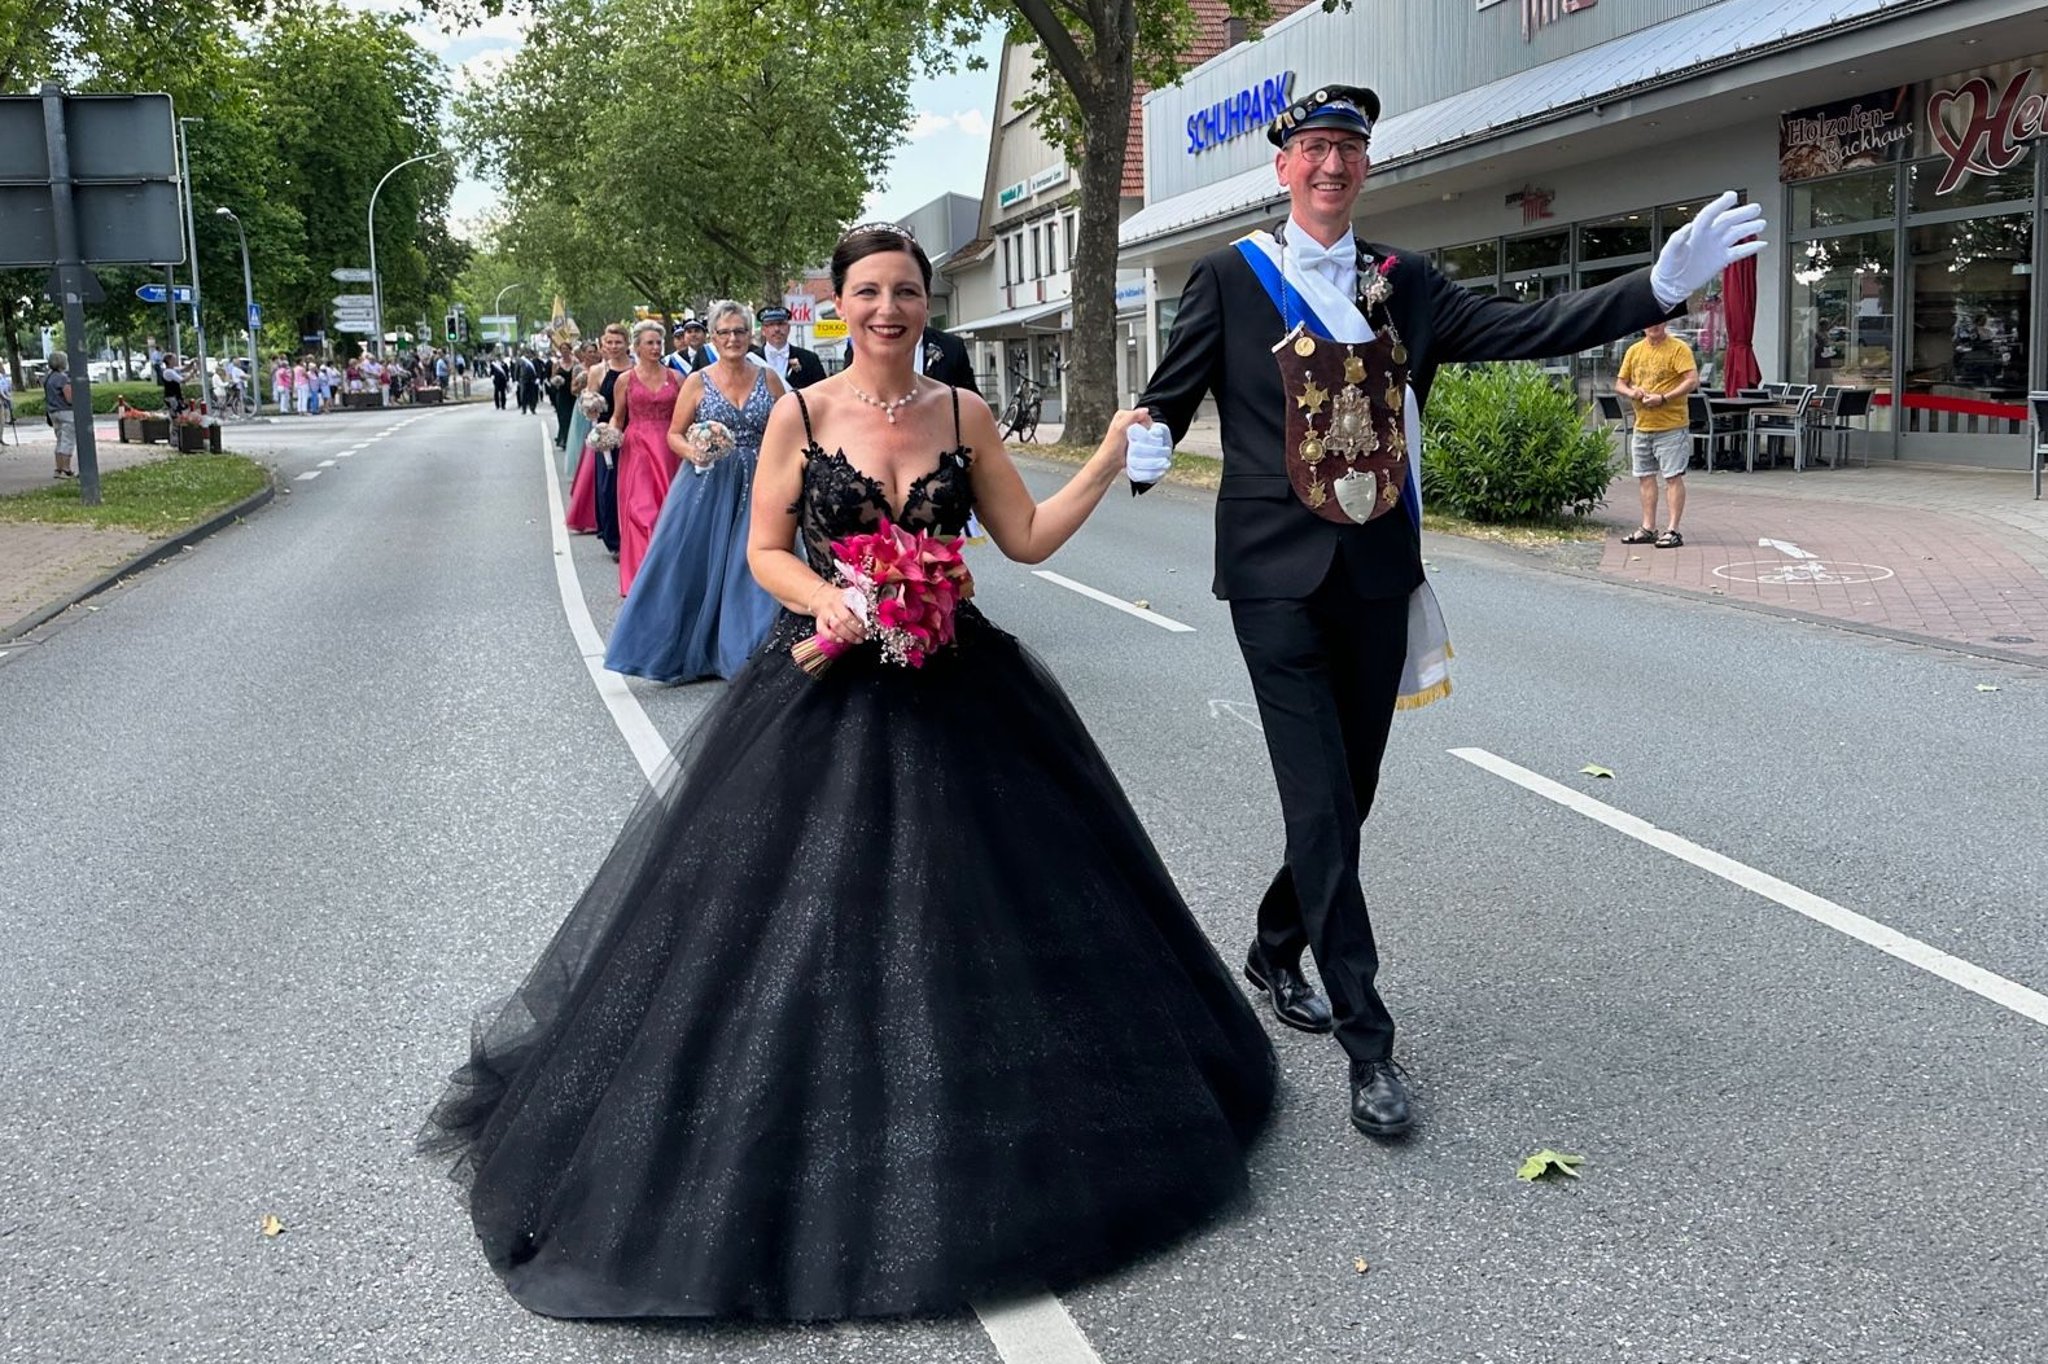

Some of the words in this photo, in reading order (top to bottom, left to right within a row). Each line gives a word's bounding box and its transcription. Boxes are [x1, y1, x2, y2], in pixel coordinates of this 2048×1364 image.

[1187, 71, 1294, 154] SCHUHPARK
[1787, 104, 1895, 146] Holzofen-
[1824, 122, 1913, 164] Backhaus
